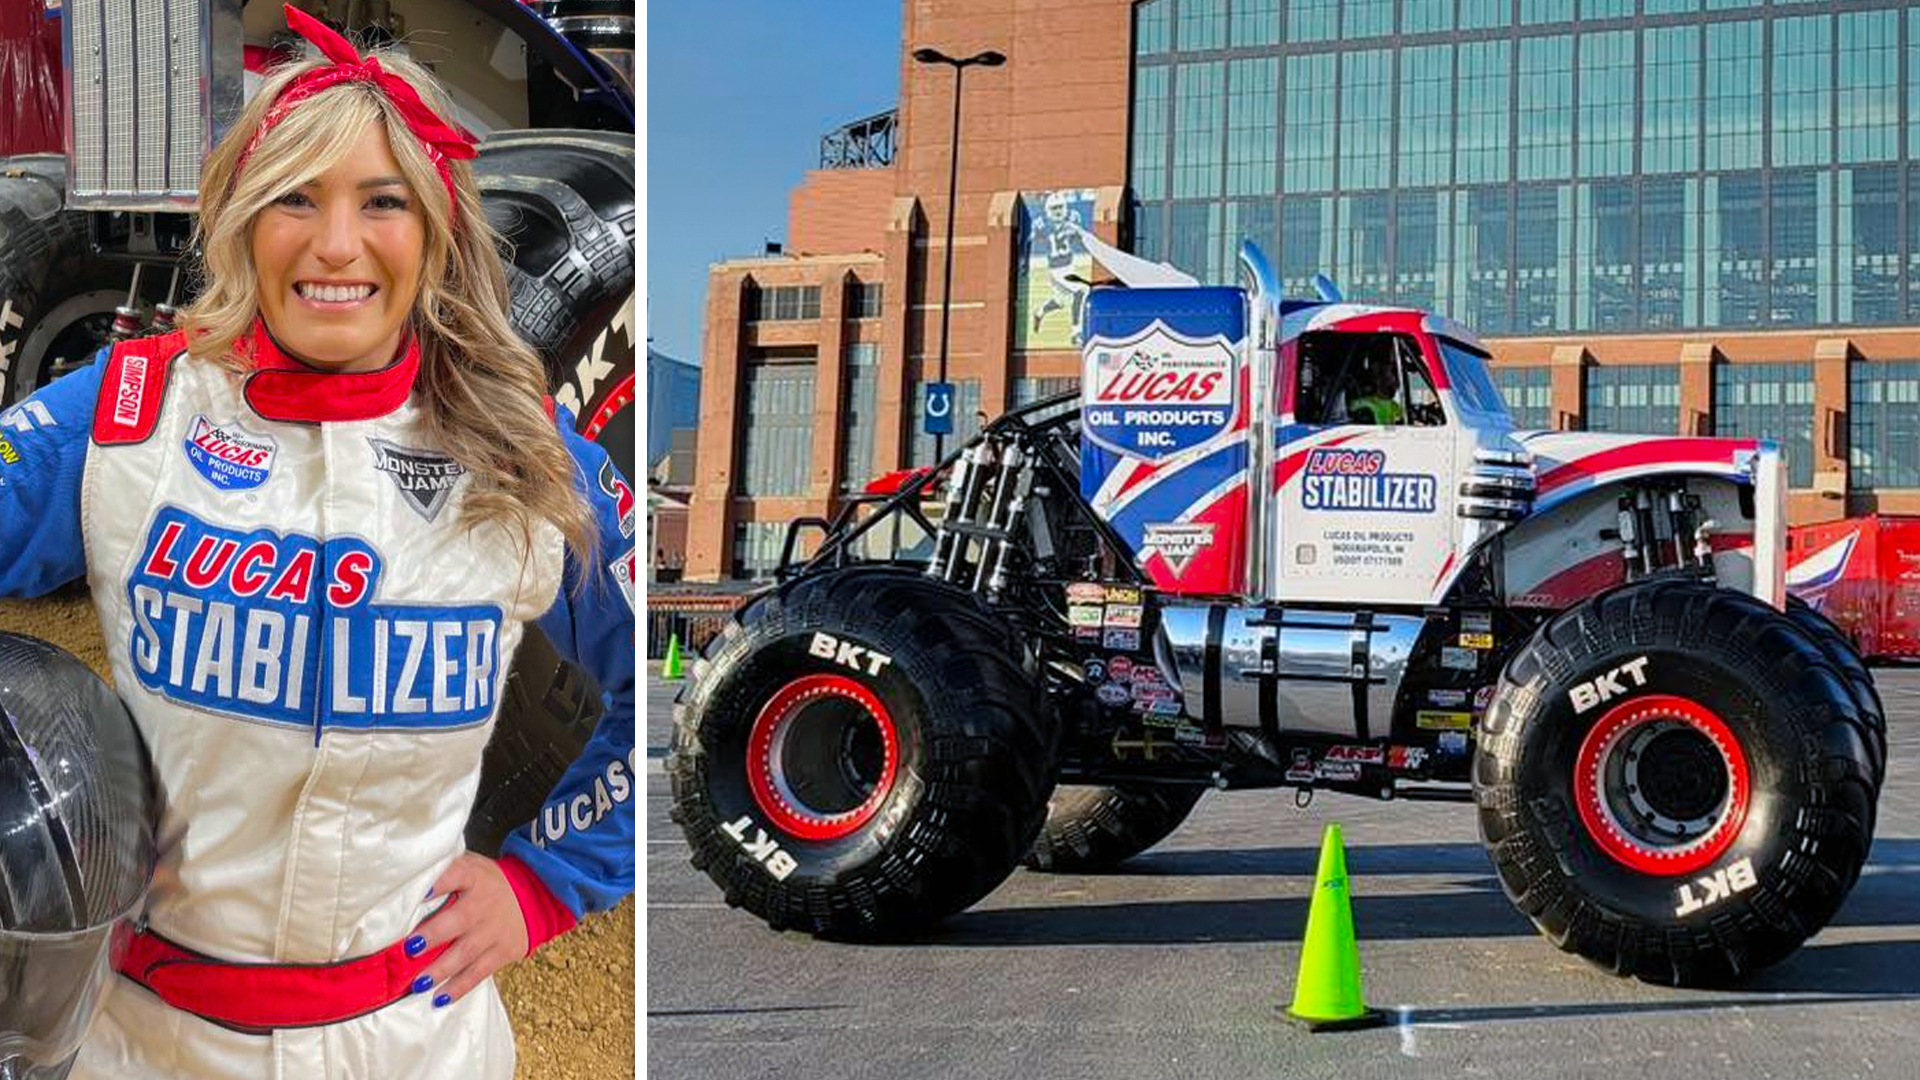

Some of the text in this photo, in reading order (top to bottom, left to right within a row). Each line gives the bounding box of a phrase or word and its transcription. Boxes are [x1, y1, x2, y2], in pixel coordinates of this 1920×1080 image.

[117, 357, 145, 421] SIMPSON
[1097, 371, 1223, 401] LUCAS
[1089, 410, 1225, 425] OIL PRODUCTS
[193, 433, 269, 466] LUCAS
[1137, 431, 1177, 446] INC.
[190, 446, 262, 482] OIL PRODUCTS
[211, 470, 231, 486] INC.
[1311, 452, 1382, 473] LUCAS
[400, 474, 449, 490] JAM
[1304, 475, 1434, 509] STABILIZER
[1142, 534, 1214, 545] MONSTER
[1167, 545, 1197, 556] JAM
[1323, 531, 1414, 542] LUCAS OIL PRODUCTS
[144, 521, 373, 608] LUCAS
[133, 584, 496, 715] STABILIZER
[807, 630, 892, 677] BKT
[1568, 656, 1650, 715] BKT
[721, 815, 799, 882] BKT
[1674, 856, 1759, 918] BKT
